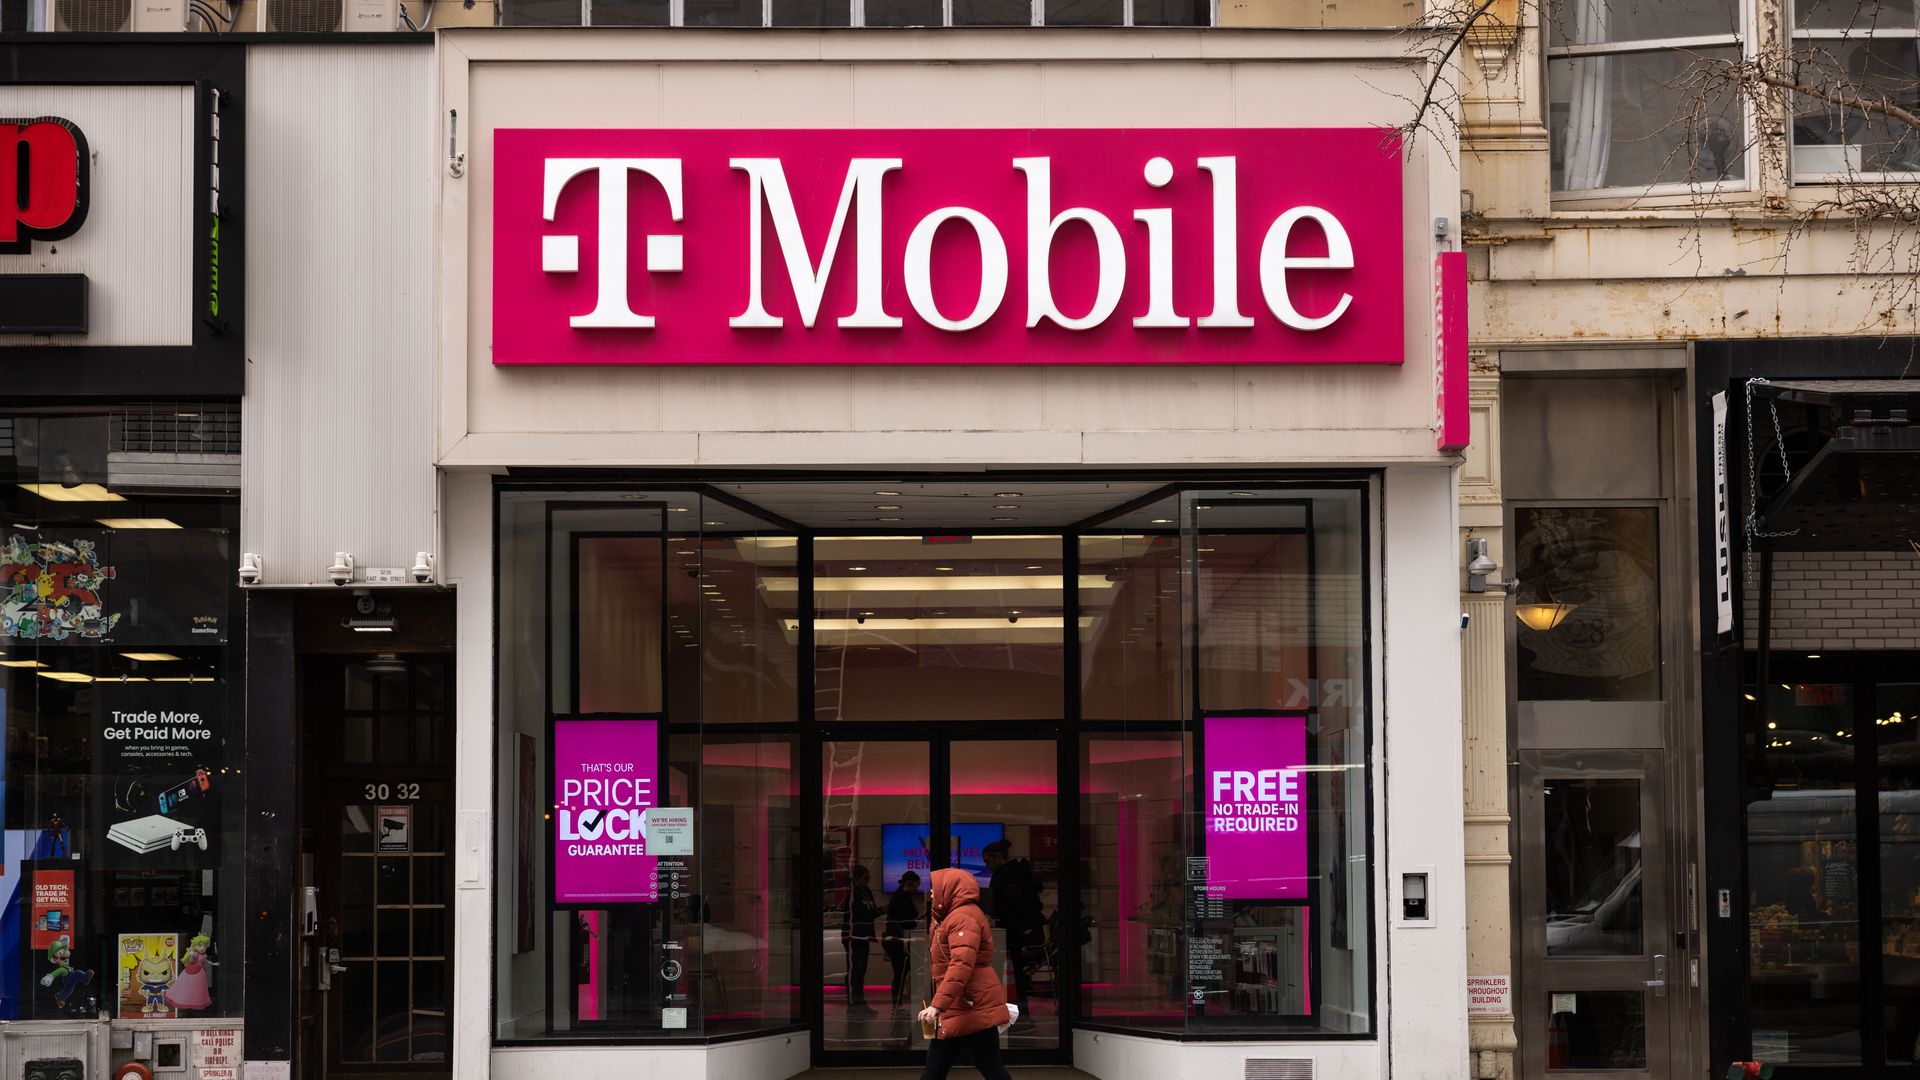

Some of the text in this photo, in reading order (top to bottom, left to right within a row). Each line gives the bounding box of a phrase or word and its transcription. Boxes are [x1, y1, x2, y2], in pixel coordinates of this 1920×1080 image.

[542, 156, 1354, 332] T Mobile
[1719, 482, 1729, 603] LUSH
[112, 710, 203, 725] Trade More,
[104, 726, 211, 740] Get Paid More
[581, 763, 634, 772] THAT'S OUR
[365, 783, 420, 800] 30 32
[564, 778, 651, 806] PRICE
[1213, 770, 1298, 802] FREE
[1213, 803, 1298, 815] NO TRADE-IN
[560, 808, 646, 841] LOCK
[1214, 817, 1298, 832] REQUIRED
[568, 844, 643, 856] GUARANTEE
[202, 1037, 234, 1046] CALL POLICE
